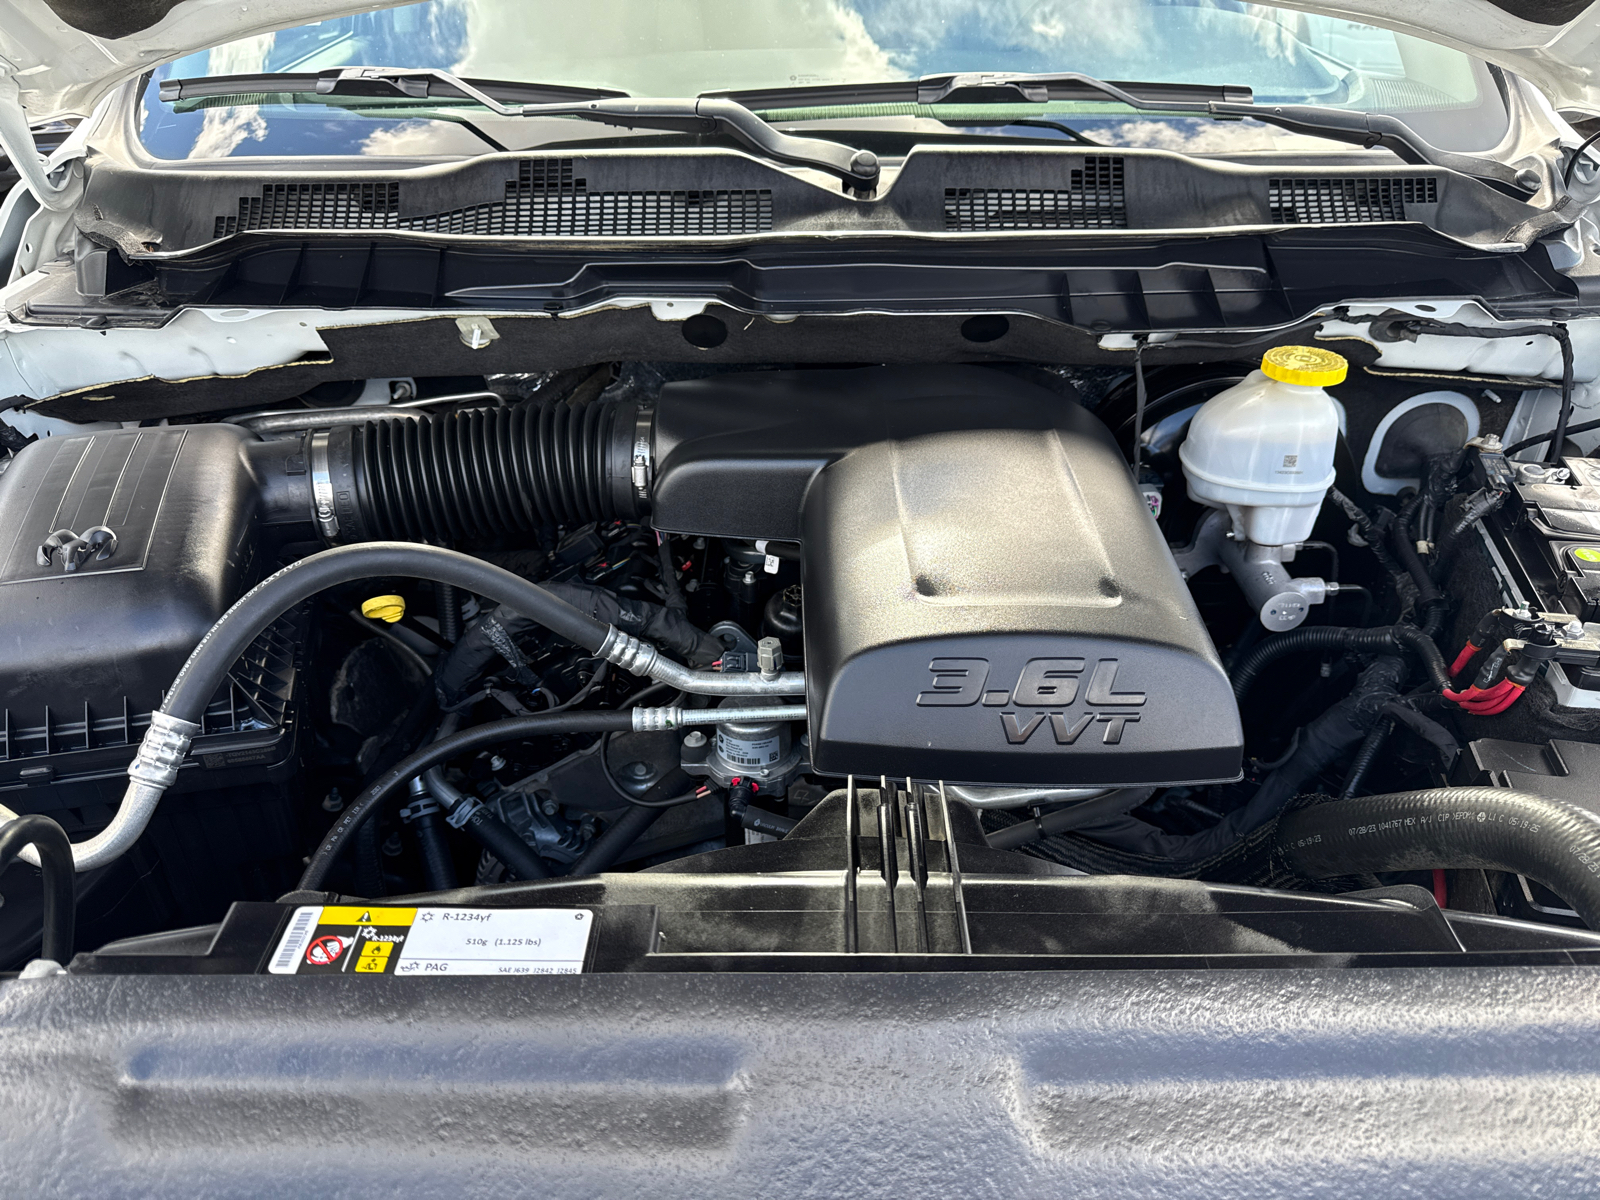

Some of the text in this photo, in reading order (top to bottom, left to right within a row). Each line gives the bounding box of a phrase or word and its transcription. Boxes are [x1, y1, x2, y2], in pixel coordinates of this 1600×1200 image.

[915, 656, 1147, 708] 3.6L
[1000, 711, 1141, 745] VVT
[442, 912, 492, 923] R-1234yf
[465, 938, 542, 947] 510g (1.125 lbs)
[424, 962, 449, 972] PAG
